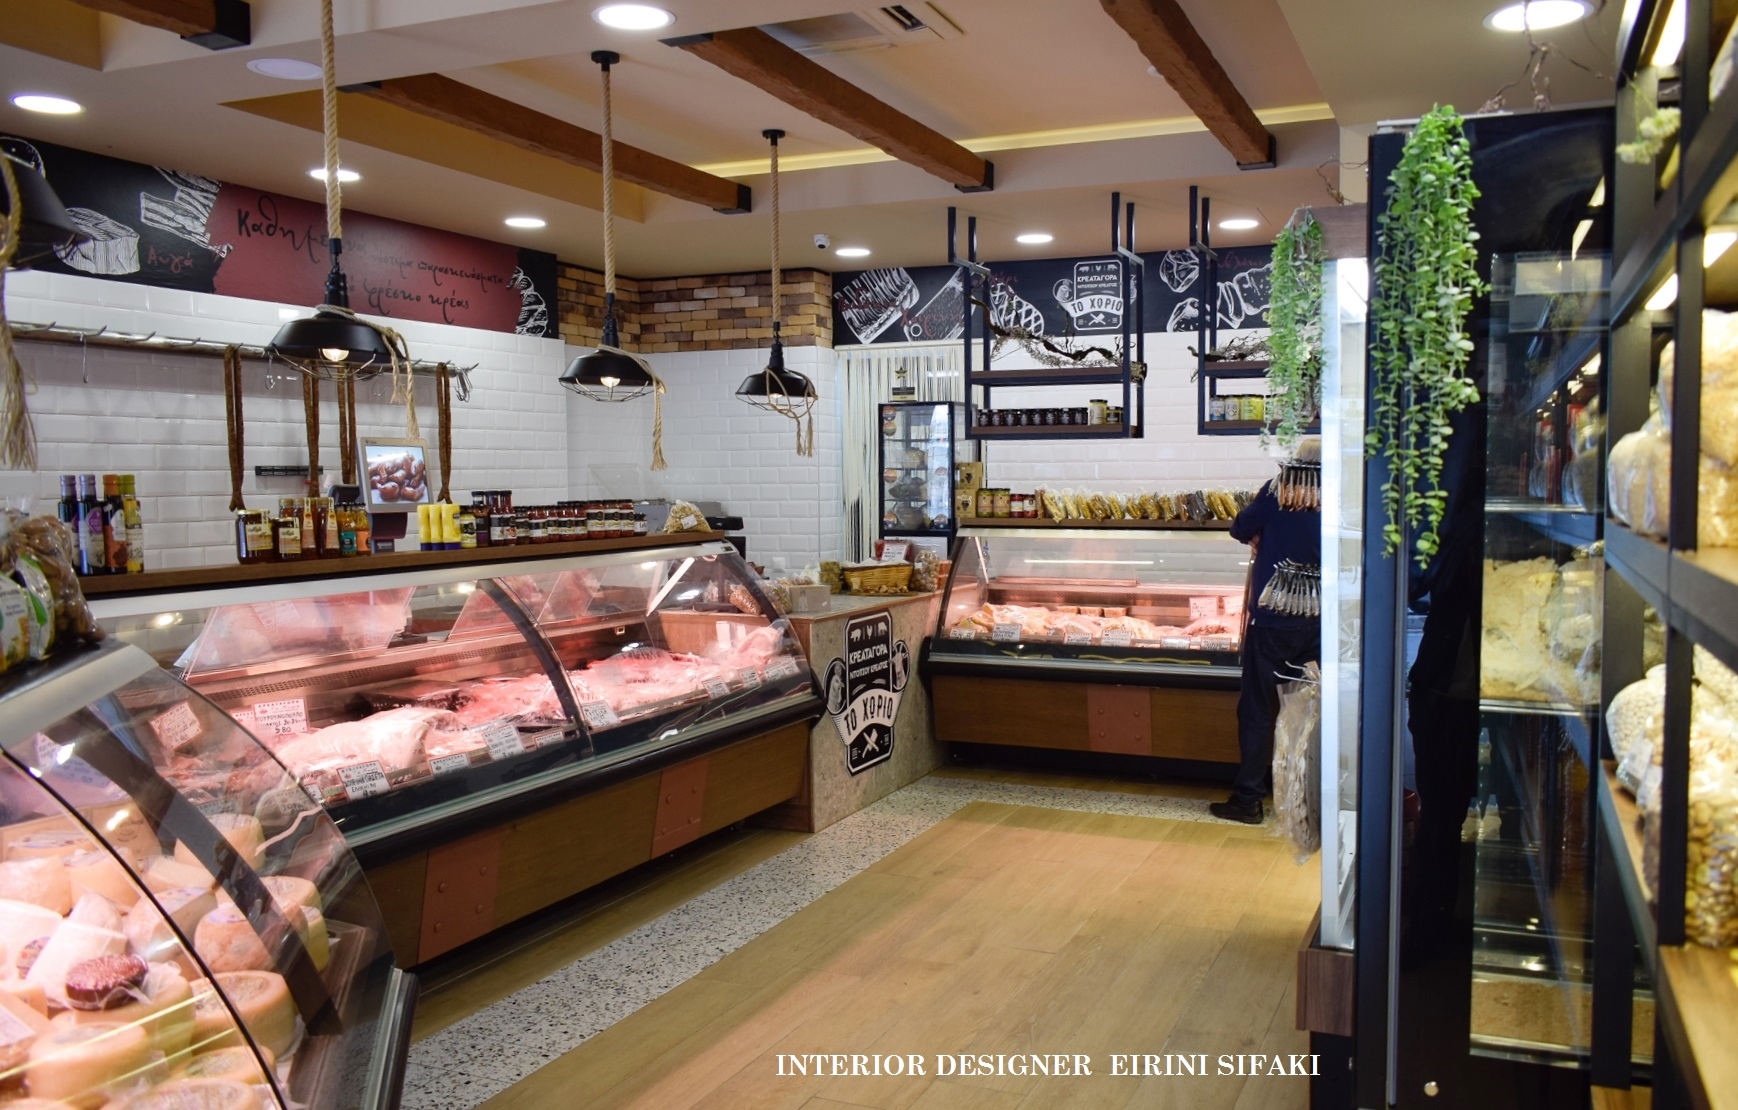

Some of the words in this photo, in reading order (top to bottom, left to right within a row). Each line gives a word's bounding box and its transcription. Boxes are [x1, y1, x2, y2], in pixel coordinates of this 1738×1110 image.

[148, 246, 193, 273] Αυγά
[1077, 274, 1118, 283] ΚΡΕΑΤΑΓΟΡΑ
[363, 279, 421, 316] φρέσκο
[1071, 301, 1084, 313] ΤΟ
[849, 643, 888, 664] ΚΡΕΑΤΑΓΟΡΑ
[844, 708, 857, 736] ΤΟ
